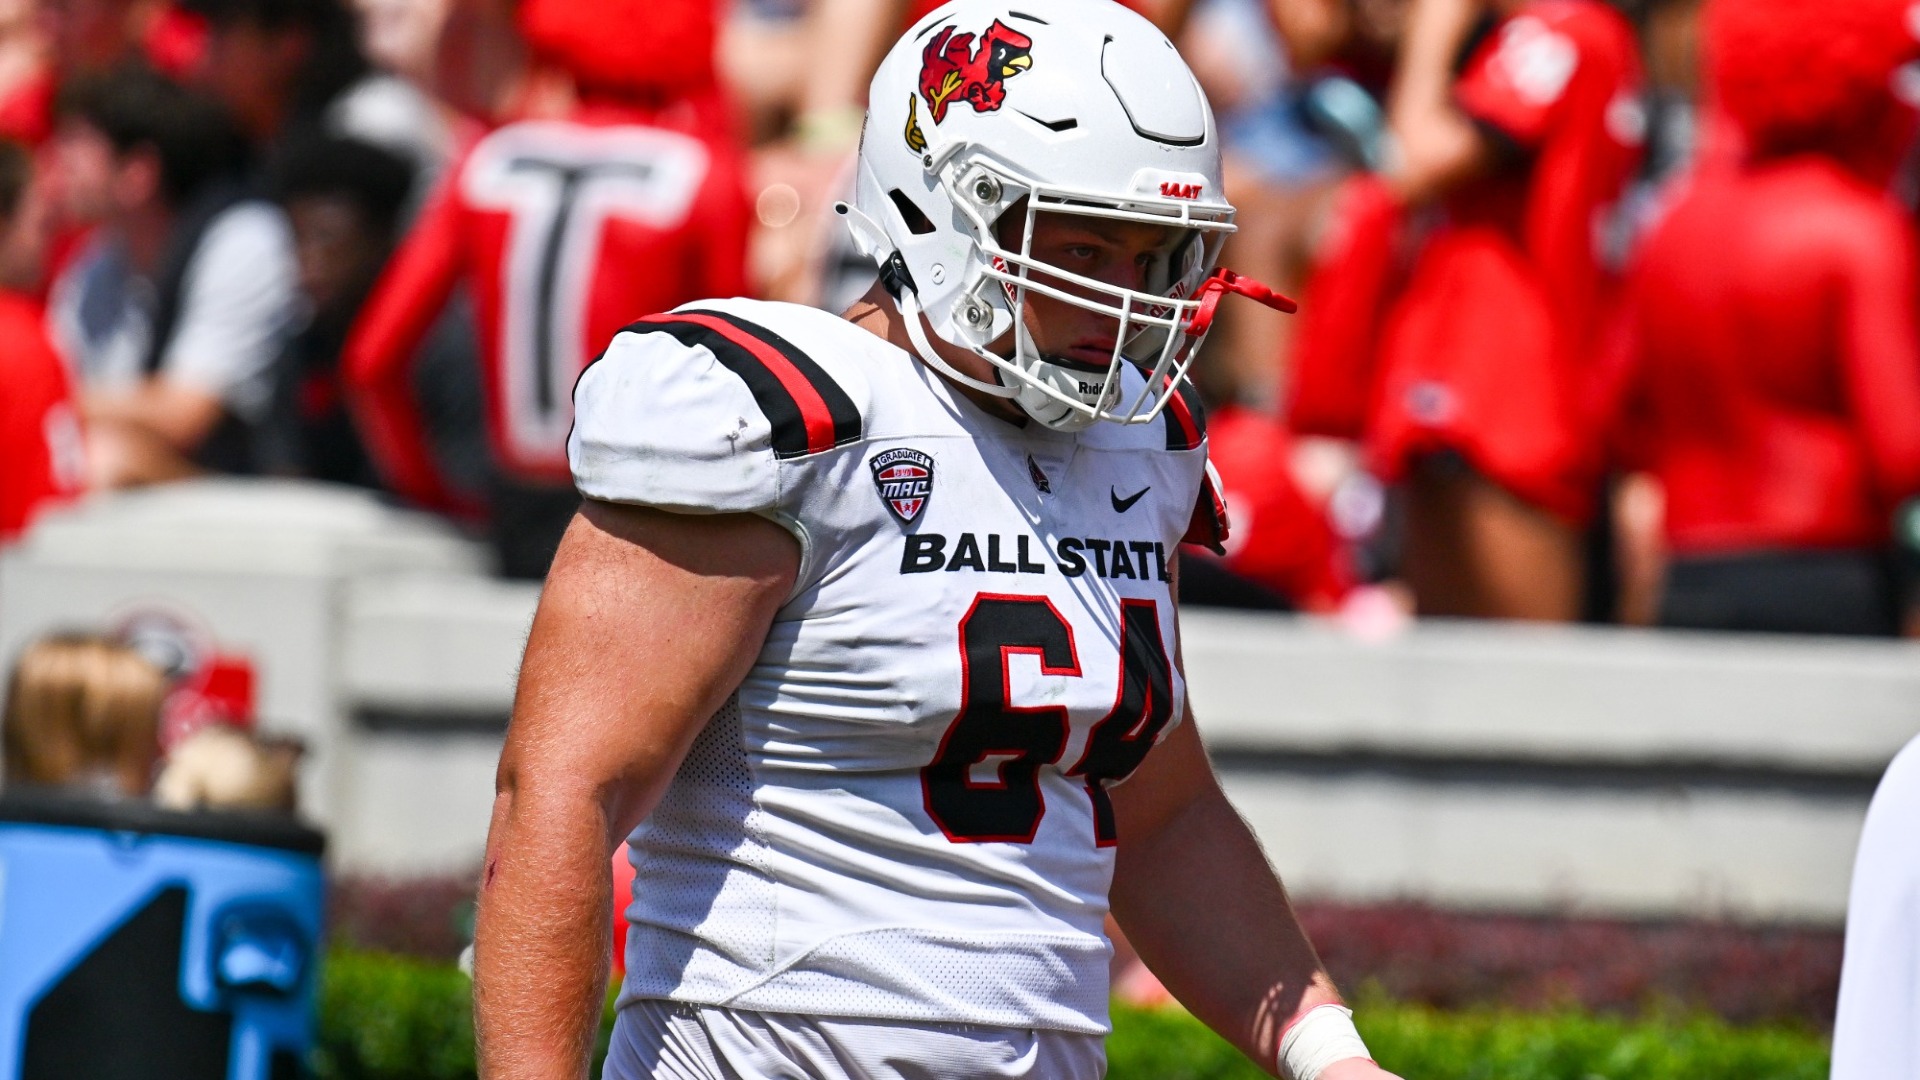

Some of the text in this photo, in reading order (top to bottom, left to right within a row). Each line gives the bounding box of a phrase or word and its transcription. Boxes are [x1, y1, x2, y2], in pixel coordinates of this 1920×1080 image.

[1160, 182, 1202, 199] 1AAT
[880, 450, 923, 464] GRADUATE
[881, 480, 930, 498] MAC
[900, 533, 1045, 574] BALL
[920, 591, 1174, 848] 64
